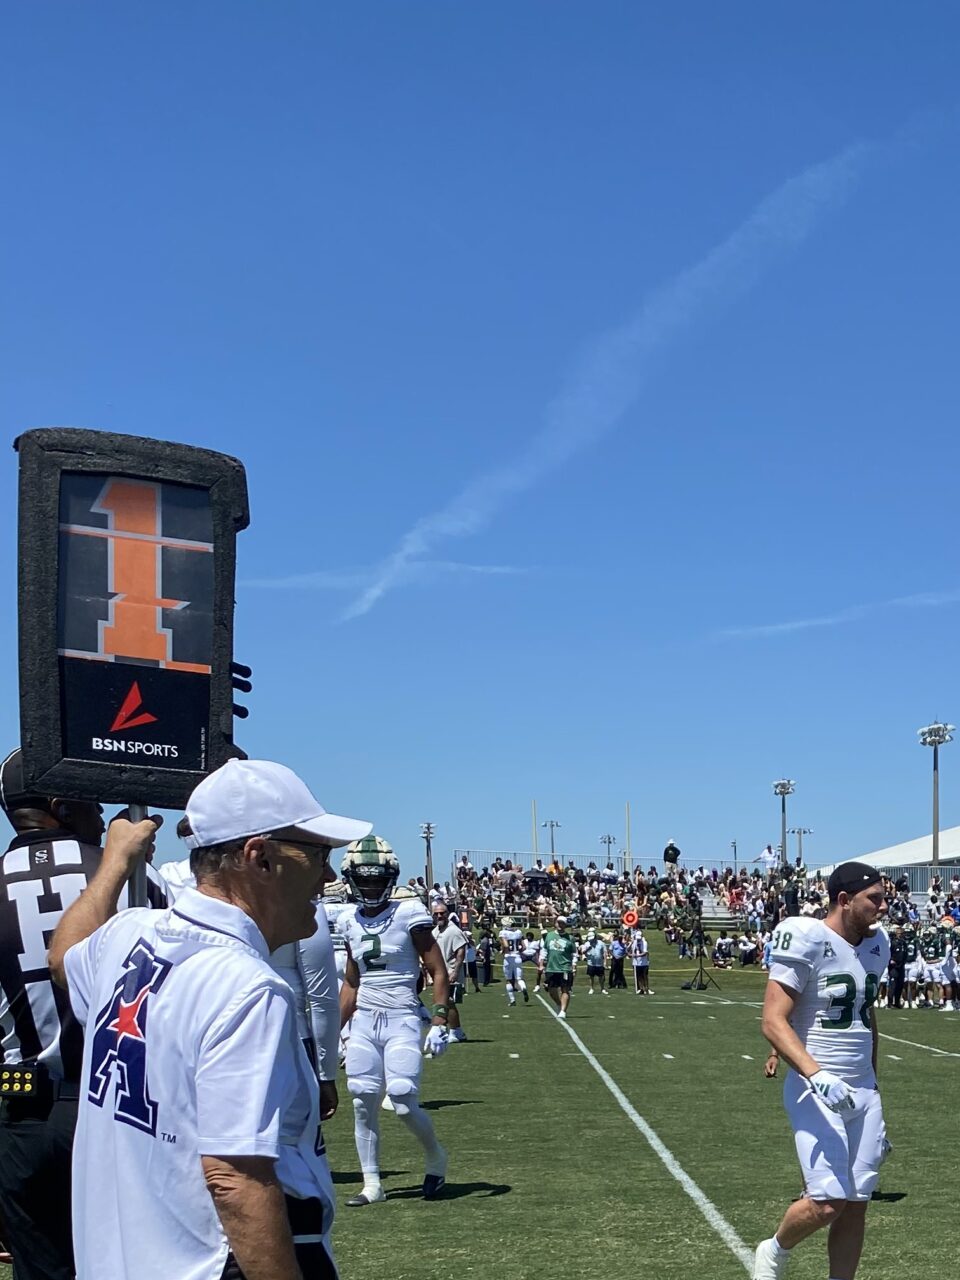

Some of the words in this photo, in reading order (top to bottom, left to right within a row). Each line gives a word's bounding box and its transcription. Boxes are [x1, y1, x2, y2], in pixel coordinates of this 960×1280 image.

[91, 477, 173, 668] 1
[7, 873, 88, 972] H
[772, 931, 793, 951] 38
[361, 934, 387, 971] 2
[818, 971, 880, 1031] 38
[161, 1132, 177, 1145] TM
